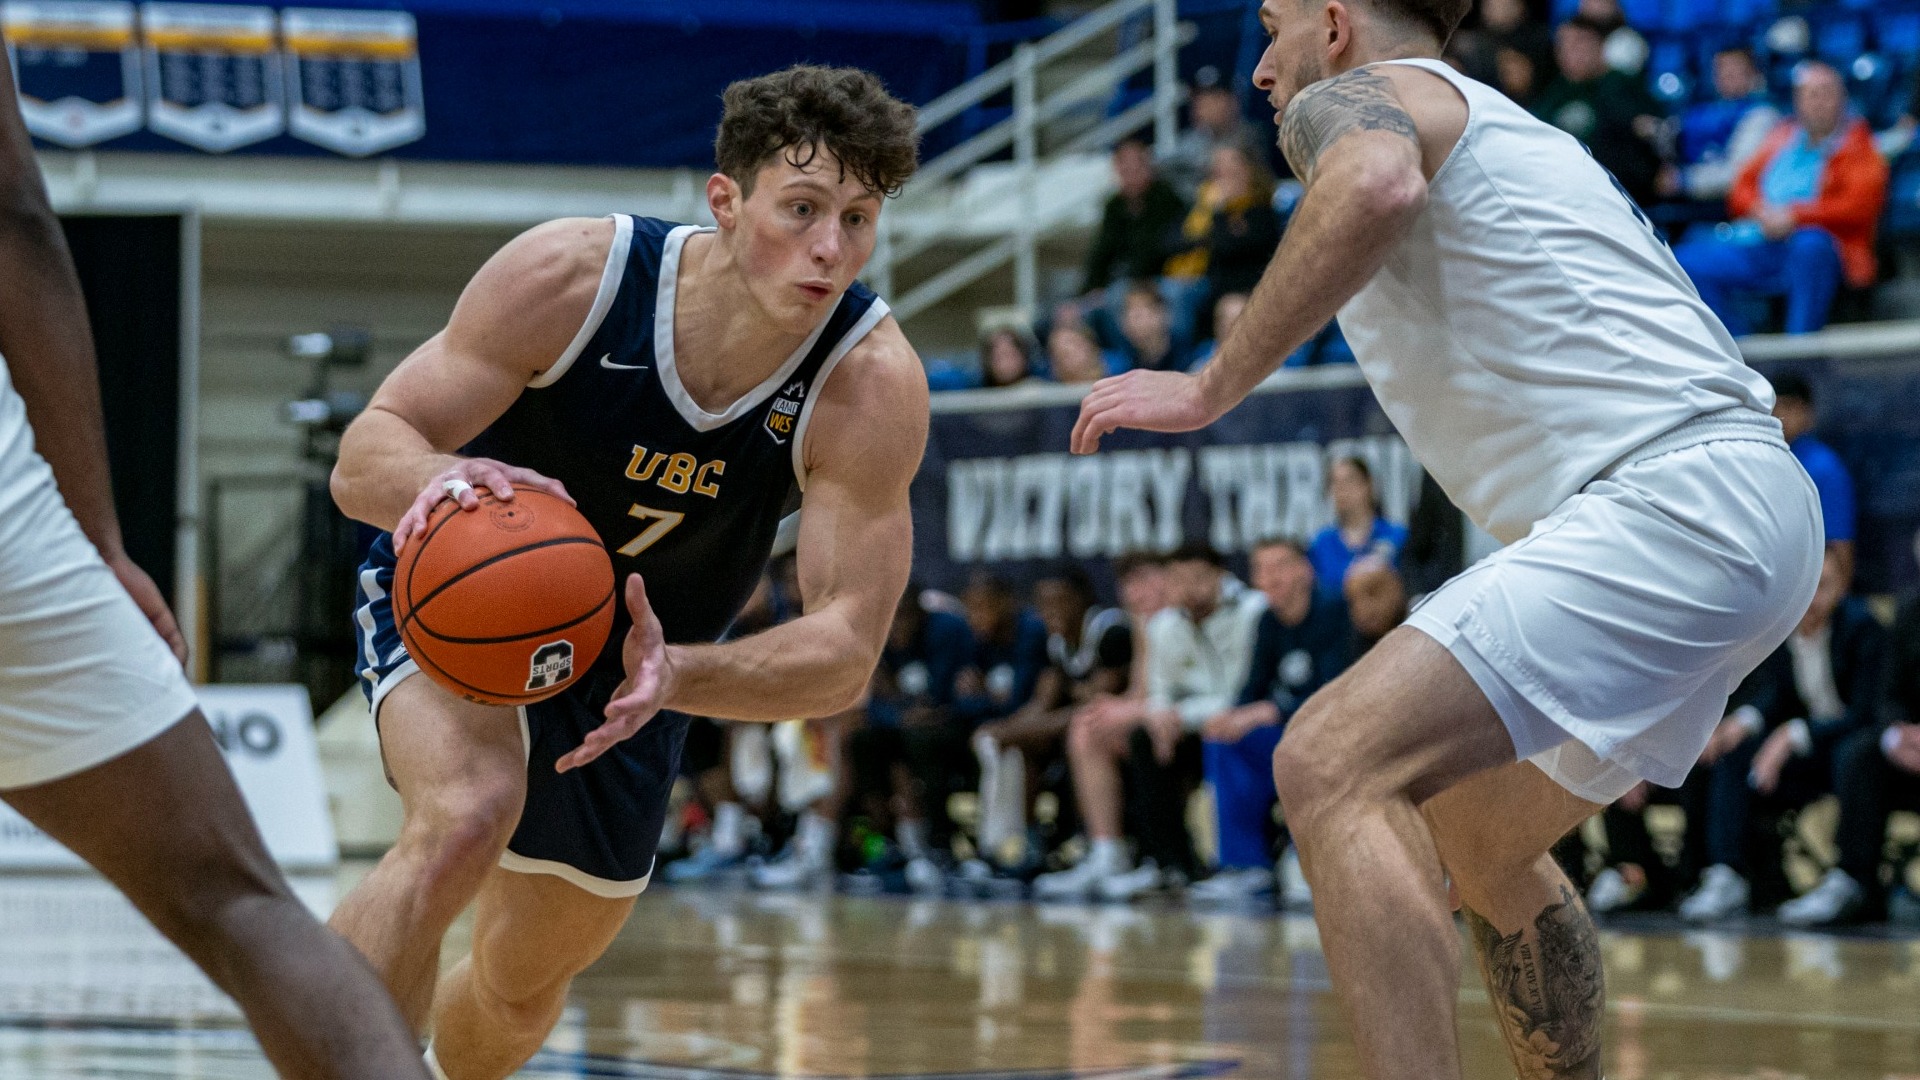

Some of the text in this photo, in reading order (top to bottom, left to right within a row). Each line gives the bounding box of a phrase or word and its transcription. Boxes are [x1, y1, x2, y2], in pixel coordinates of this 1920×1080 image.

[769, 412, 794, 433] WES
[625, 444, 726, 498] UBC
[616, 503, 685, 557] 7
[947, 447, 1191, 562] VICTORY
[532, 657, 572, 675] SPORTS
